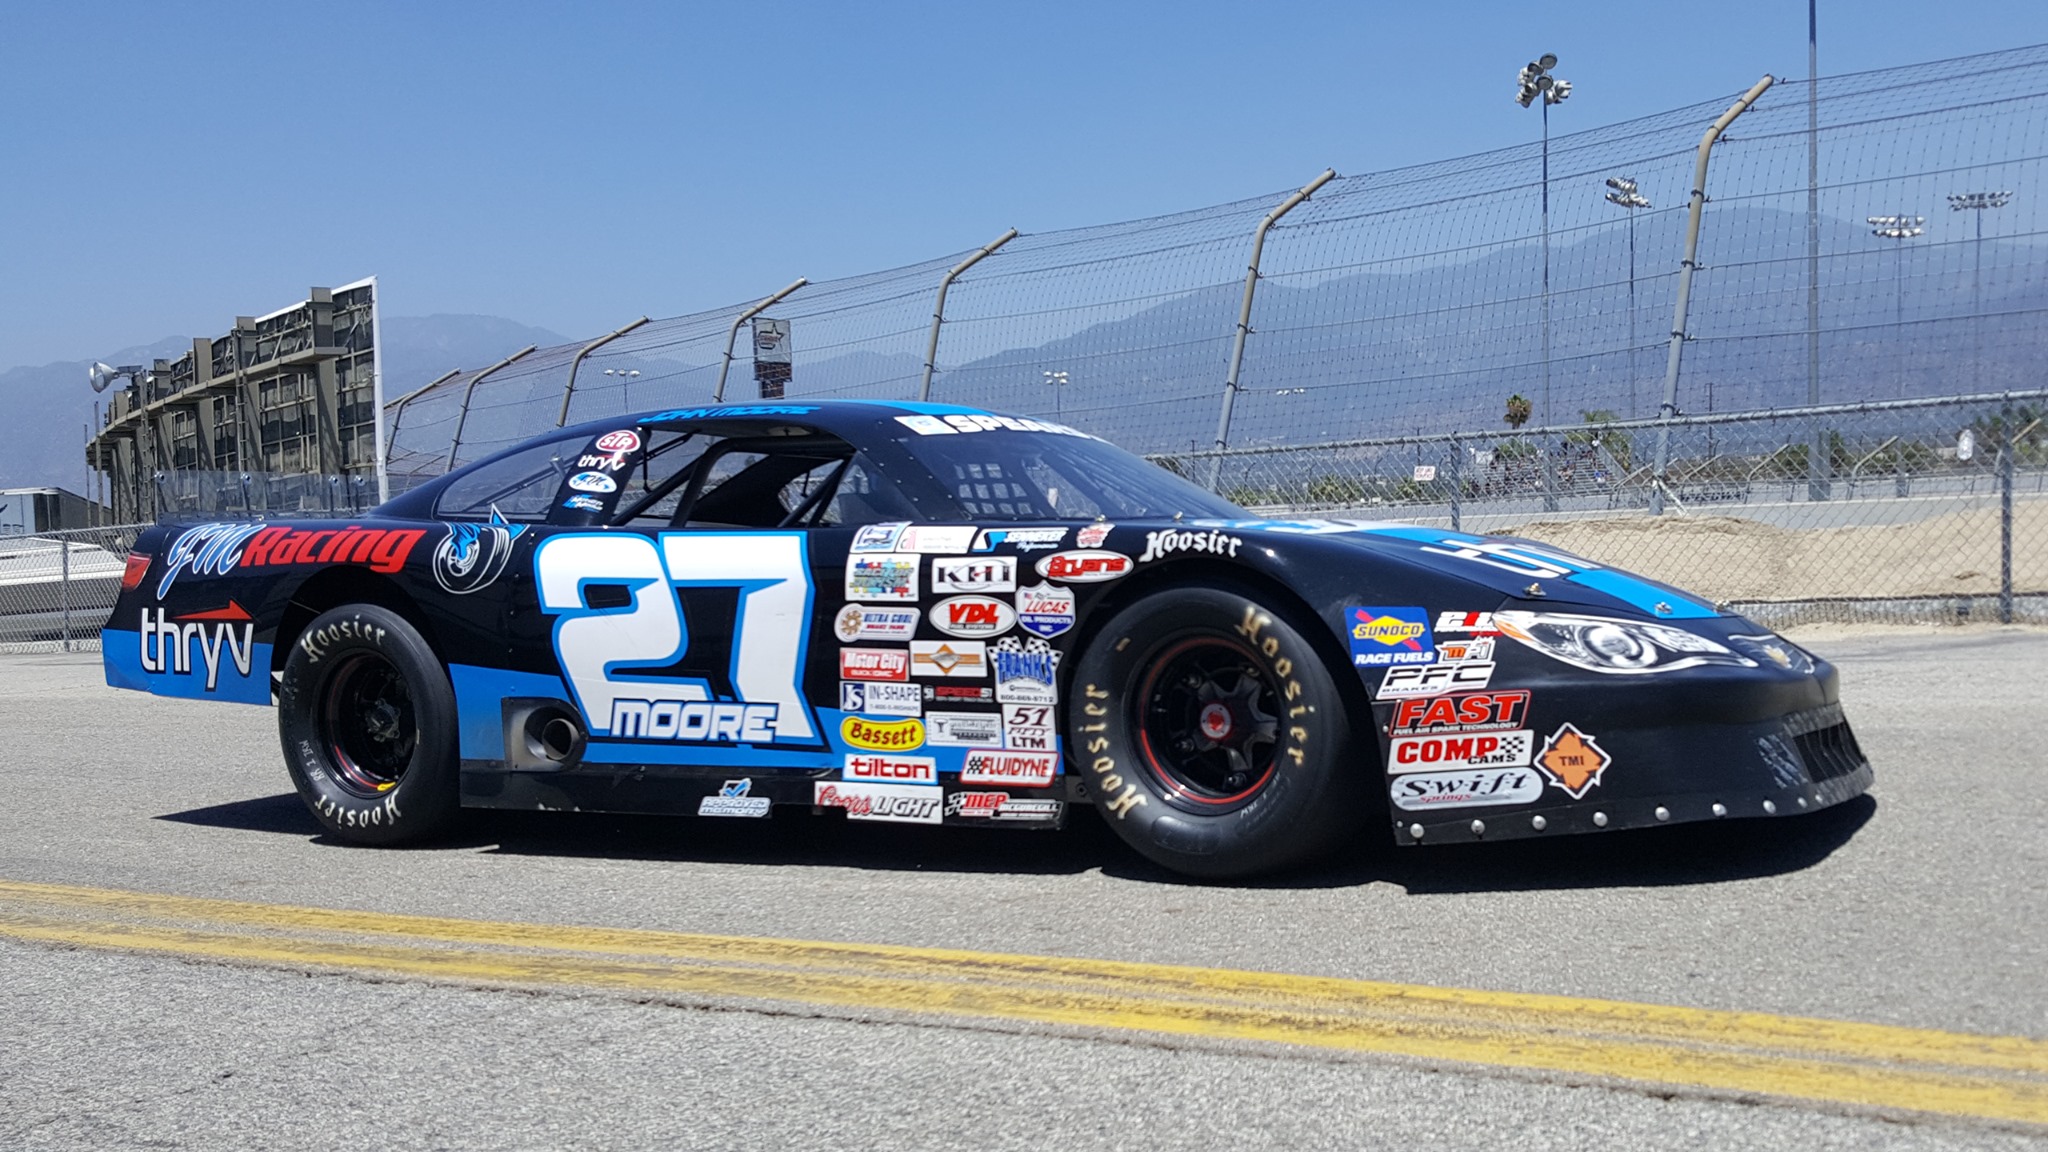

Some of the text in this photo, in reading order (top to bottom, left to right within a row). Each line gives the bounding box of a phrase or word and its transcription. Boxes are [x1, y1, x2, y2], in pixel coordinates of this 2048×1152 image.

[239, 526, 427, 574] Racing
[1139, 528, 1243, 562] Hoosier
[938, 566, 1010, 583] KHI
[1047, 555, 1127, 577] Bryans
[948, 603, 1000, 624] VDL
[1025, 601, 1070, 613] LUCAS
[1021, 615, 1072, 624] OIL PRODUCTS
[300, 613, 386, 664] Hoosier
[534, 532, 826, 746] 27
[1357, 624, 1422, 638] SUNOCO
[139, 606, 254, 693] thryv
[1355, 651, 1435, 665] RACE FUELS
[844, 652, 906, 674] Motor City
[1234, 605, 1316, 766] Hoosier
[1385, 664, 1493, 686] PFC
[869, 685, 921, 702] IN-SHAPE
[611, 698, 777, 743] MOORE
[1008, 707, 1050, 726] 51
[1397, 694, 1523, 728] FAST
[850, 722, 917, 746] Bassett
[1462, 722, 1519, 731] TECHNOLOGY
[1012, 737, 1046, 749] LTM
[1078, 684, 1149, 820] Hoosier
[1396, 736, 1499, 764] COMP
[851, 758, 931, 778] tilton
[980, 756, 1050, 777] FLUIDYNE
[1467, 753, 1517, 765] CAMS
[1558, 755, 1585, 767] TMI
[818, 785, 940, 819] Coors LIGHT
[1420, 792, 1472, 803] springs
[314, 789, 402, 829] Hoosier
